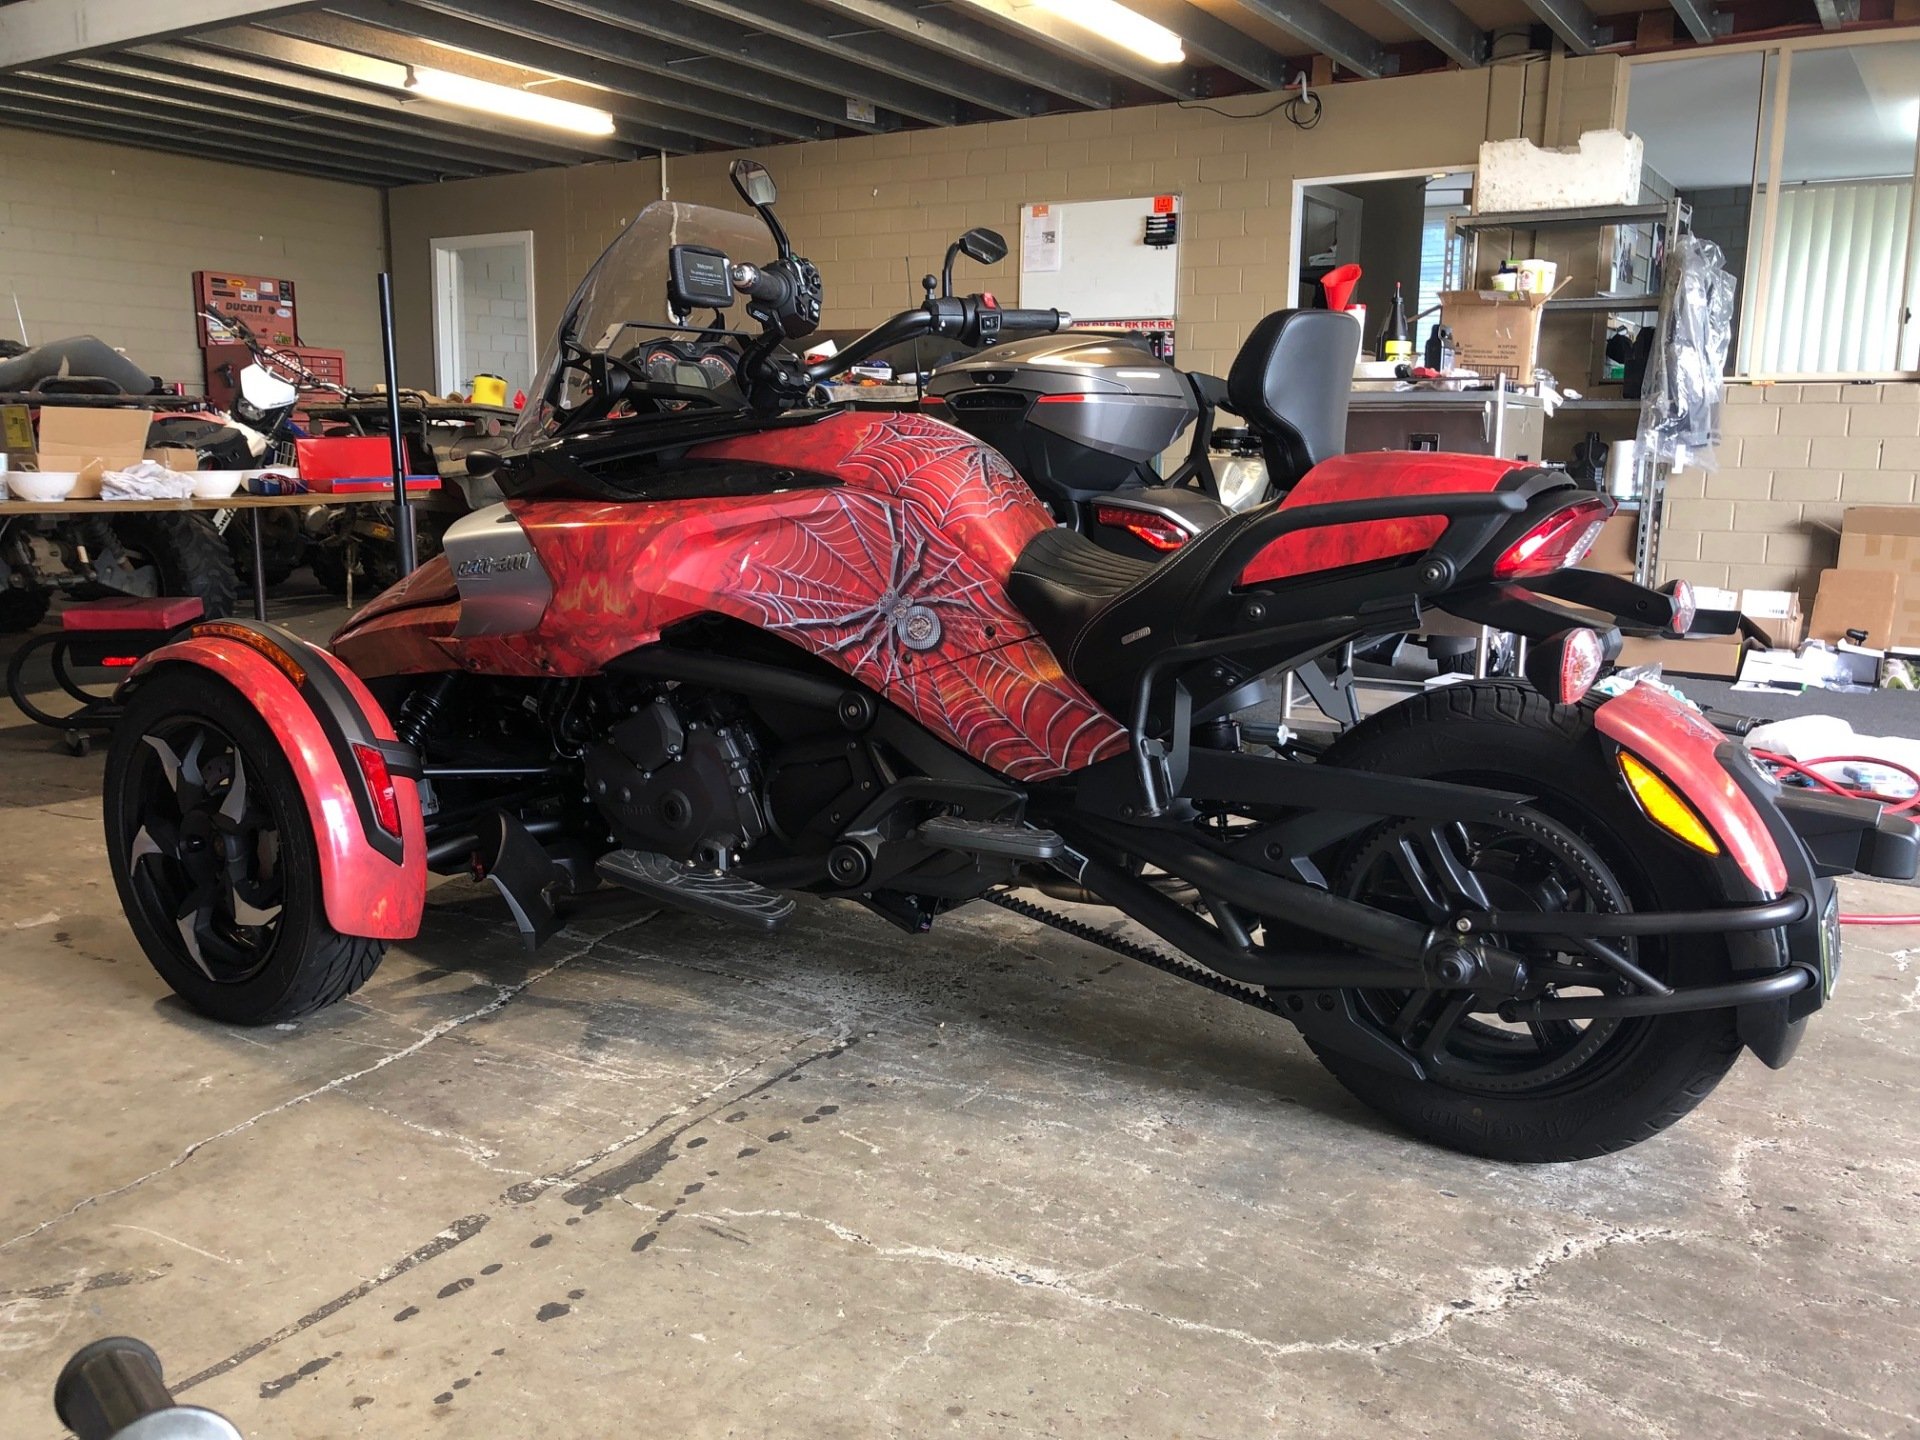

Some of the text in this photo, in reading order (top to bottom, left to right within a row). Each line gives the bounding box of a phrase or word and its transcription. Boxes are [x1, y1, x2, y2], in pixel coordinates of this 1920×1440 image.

[225, 302, 262, 313] DUCATI
[1124, 321, 1139, 329] RK
[1141, 320, 1156, 329] RK
[1158, 321, 1173, 329] RK
